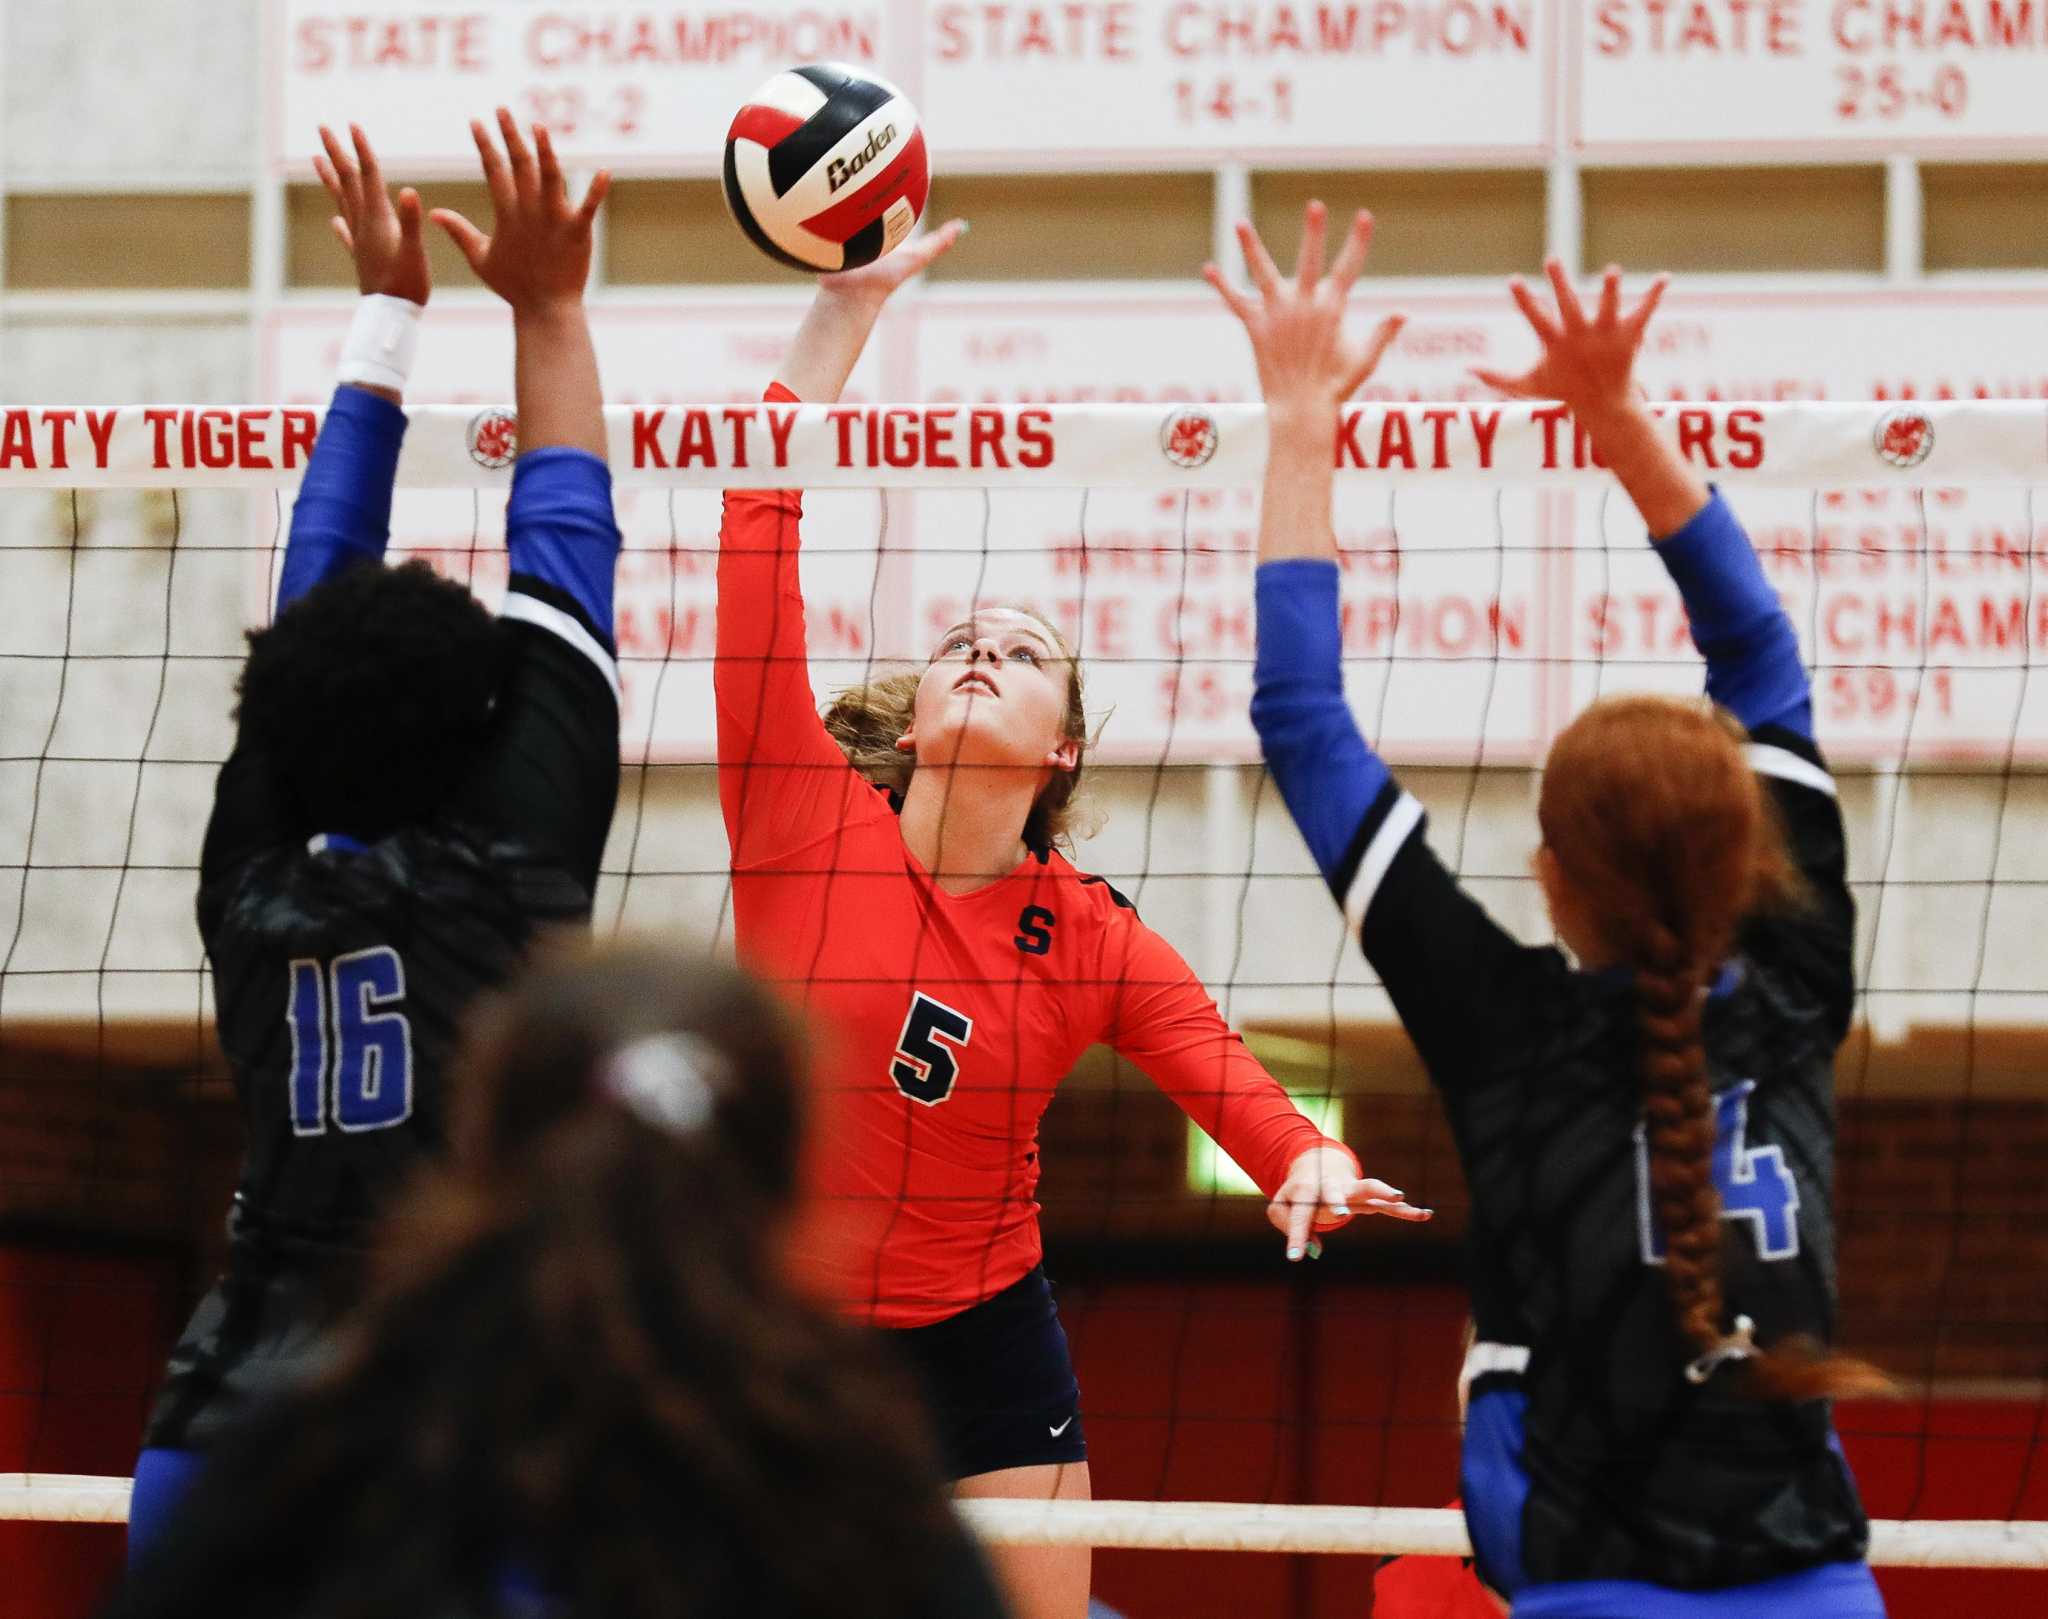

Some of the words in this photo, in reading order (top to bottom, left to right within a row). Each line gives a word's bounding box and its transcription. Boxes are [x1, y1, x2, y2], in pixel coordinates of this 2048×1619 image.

[297, 14, 487, 69] STATE
[524, 10, 876, 65] CHAMPION
[936, 4, 1136, 59] STATE
[1168, 0, 1530, 55] CHAMPION
[1597, 0, 1800, 54] STATE
[1831, 0, 2048, 50] CHAM
[1834, 63, 1968, 119] 25-0
[826, 122, 898, 195] Baden
[0, 410, 118, 468] ATY
[144, 410, 317, 468] TIGER
[632, 410, 799, 468] KATY
[826, 410, 1055, 468] TIGERS
[1335, 410, 1501, 468] KATY
[1531, 407, 1765, 469] TIRS
[1014, 904, 1056, 956] S
[286, 945, 413, 1137] 16
[889, 990, 974, 1107] 5
